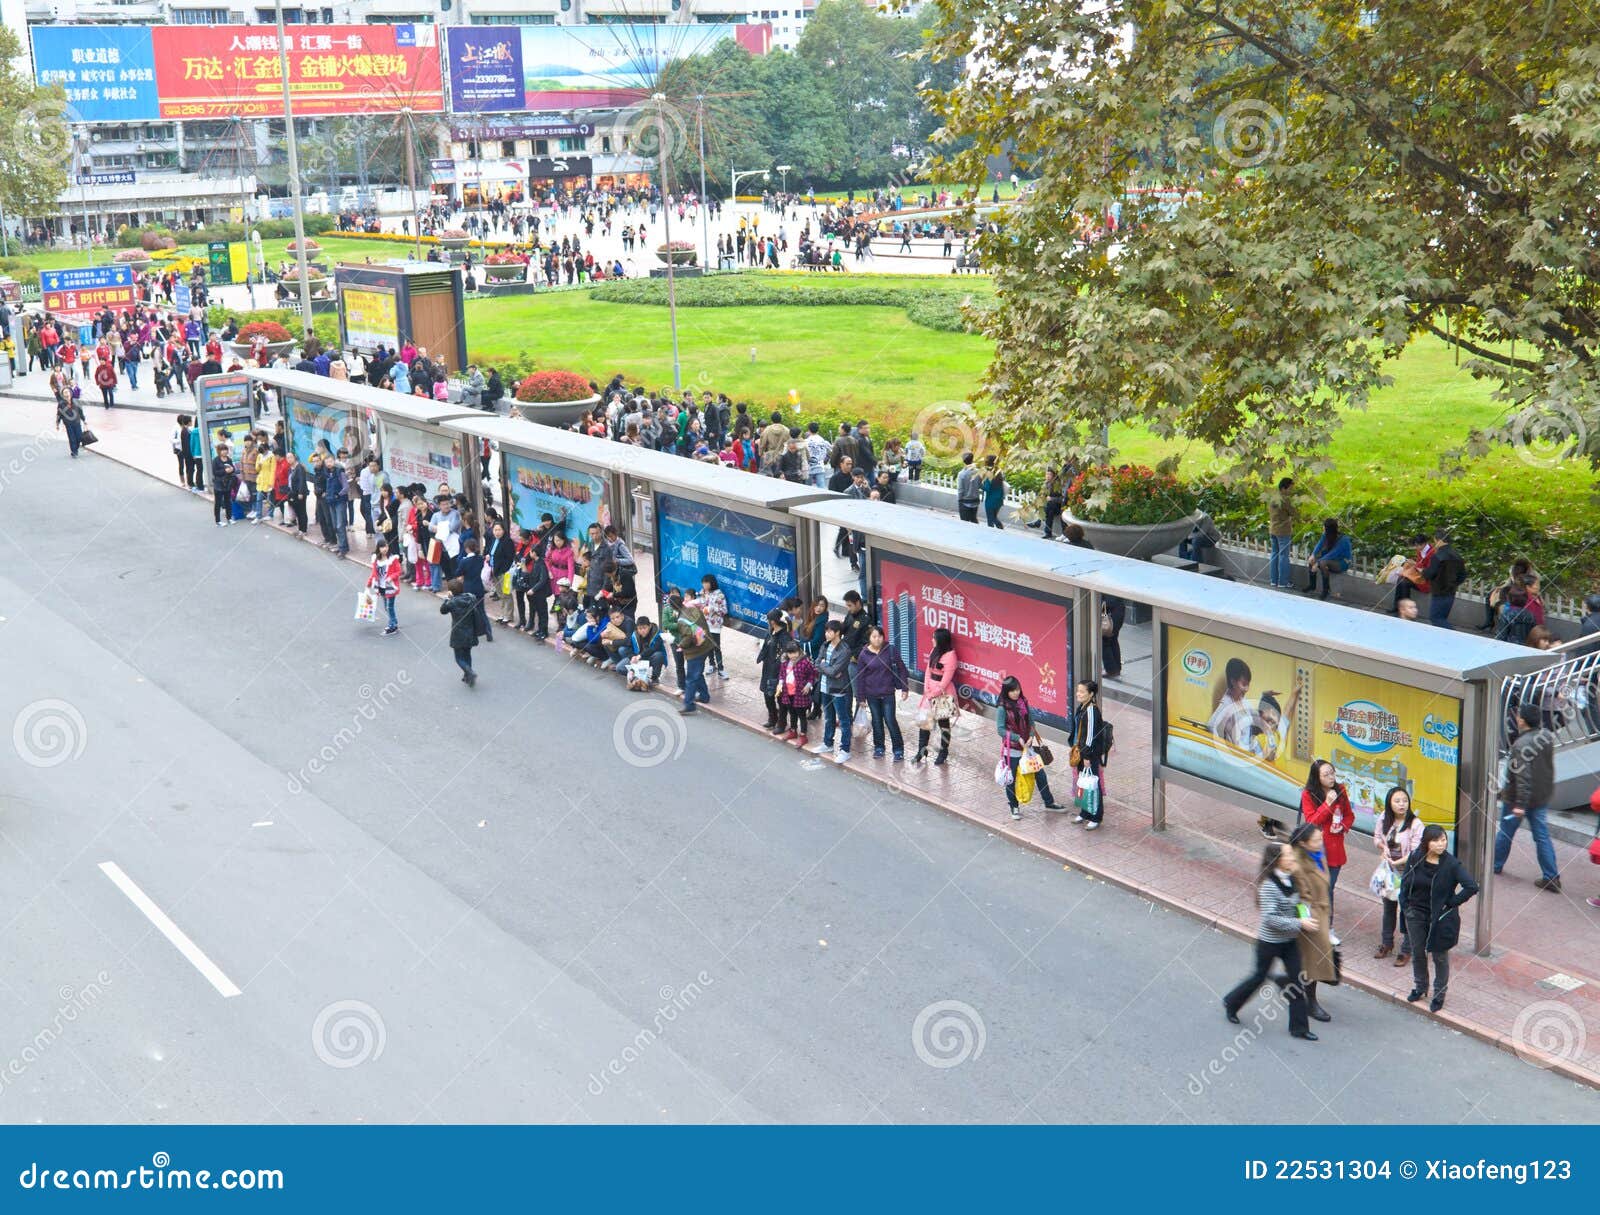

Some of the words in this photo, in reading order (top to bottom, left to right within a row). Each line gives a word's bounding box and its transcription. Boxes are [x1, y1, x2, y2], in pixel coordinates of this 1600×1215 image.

[301, 34, 362, 50] 汇聚一街
[921, 584, 965, 612] 红星金座
[1187, 655, 1207, 669] 伊利
